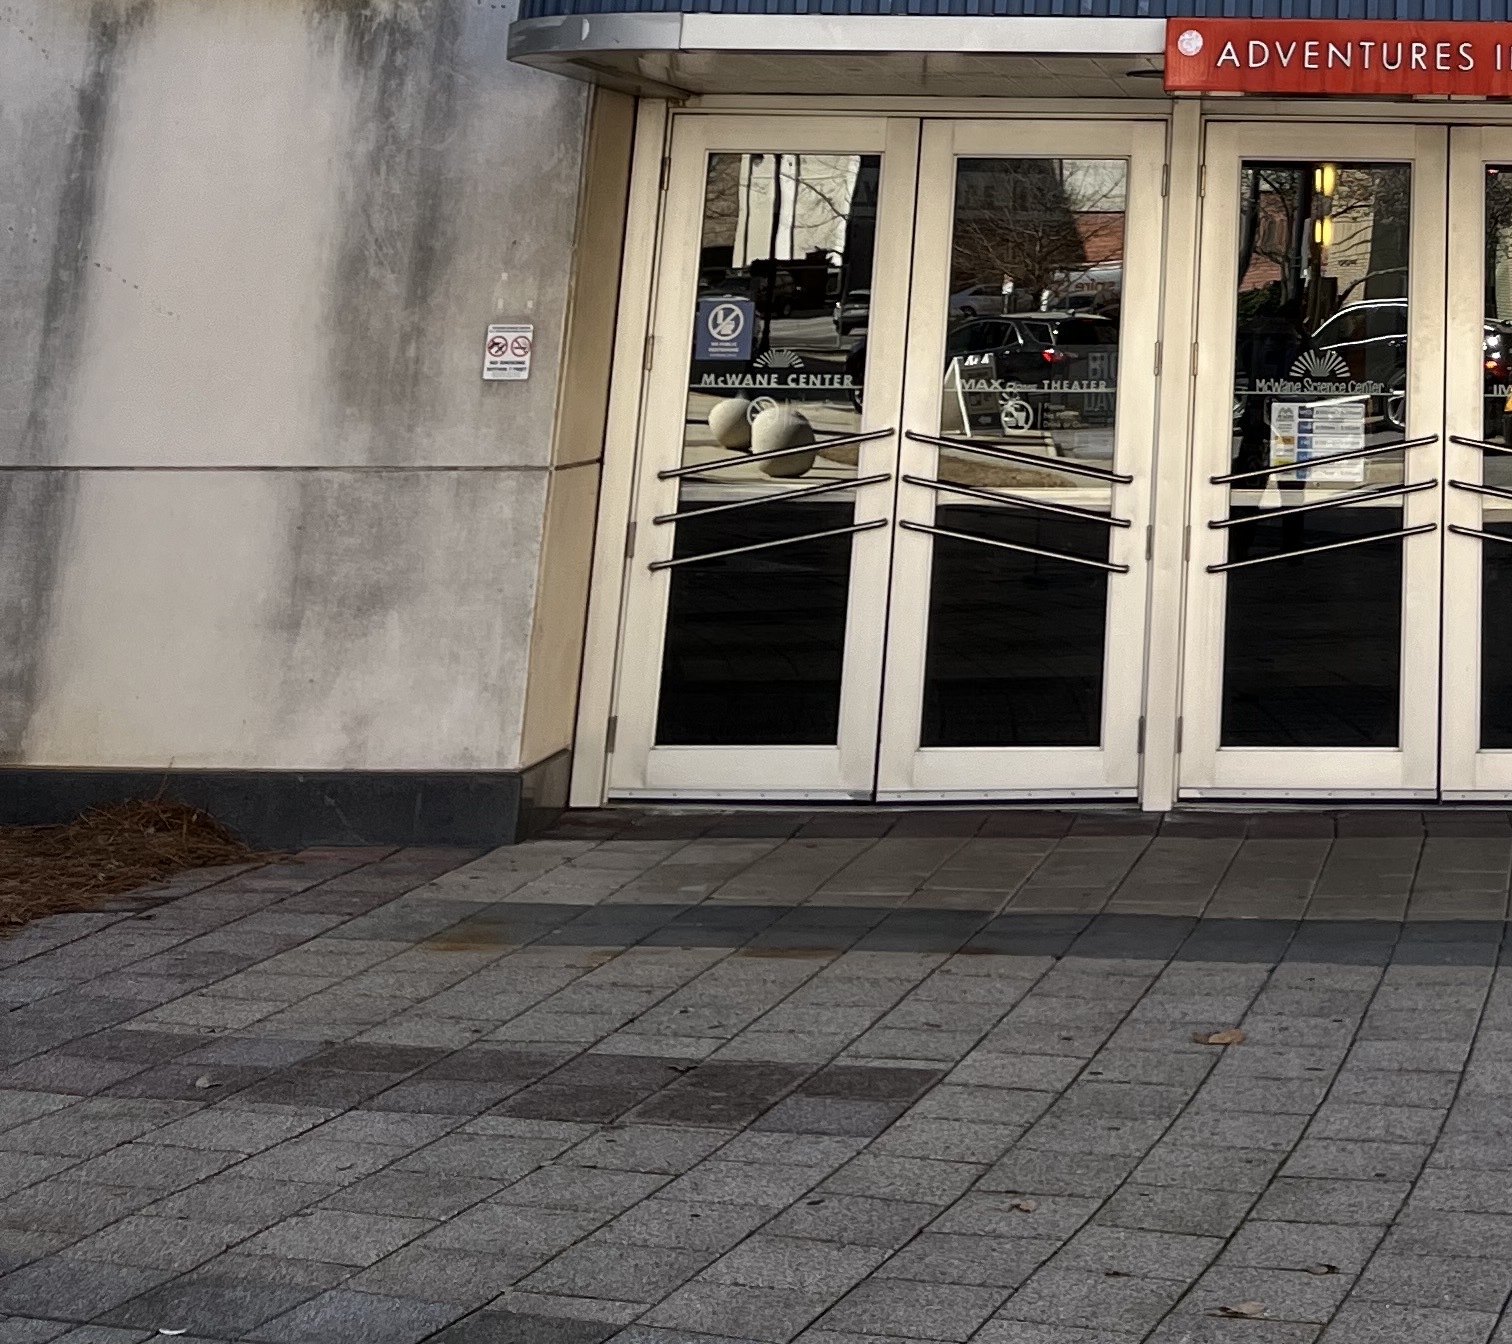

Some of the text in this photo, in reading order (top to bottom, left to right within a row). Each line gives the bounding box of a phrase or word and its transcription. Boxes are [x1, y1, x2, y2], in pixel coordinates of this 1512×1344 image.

[1216, 39, 1475, 72] ADVENTURES
[787, 373, 853, 387] CENTER
[1042, 380, 1107, 391] THEATER
[1256, 377, 1301, 393] McWane
[1303, 377, 1348, 393] Science
